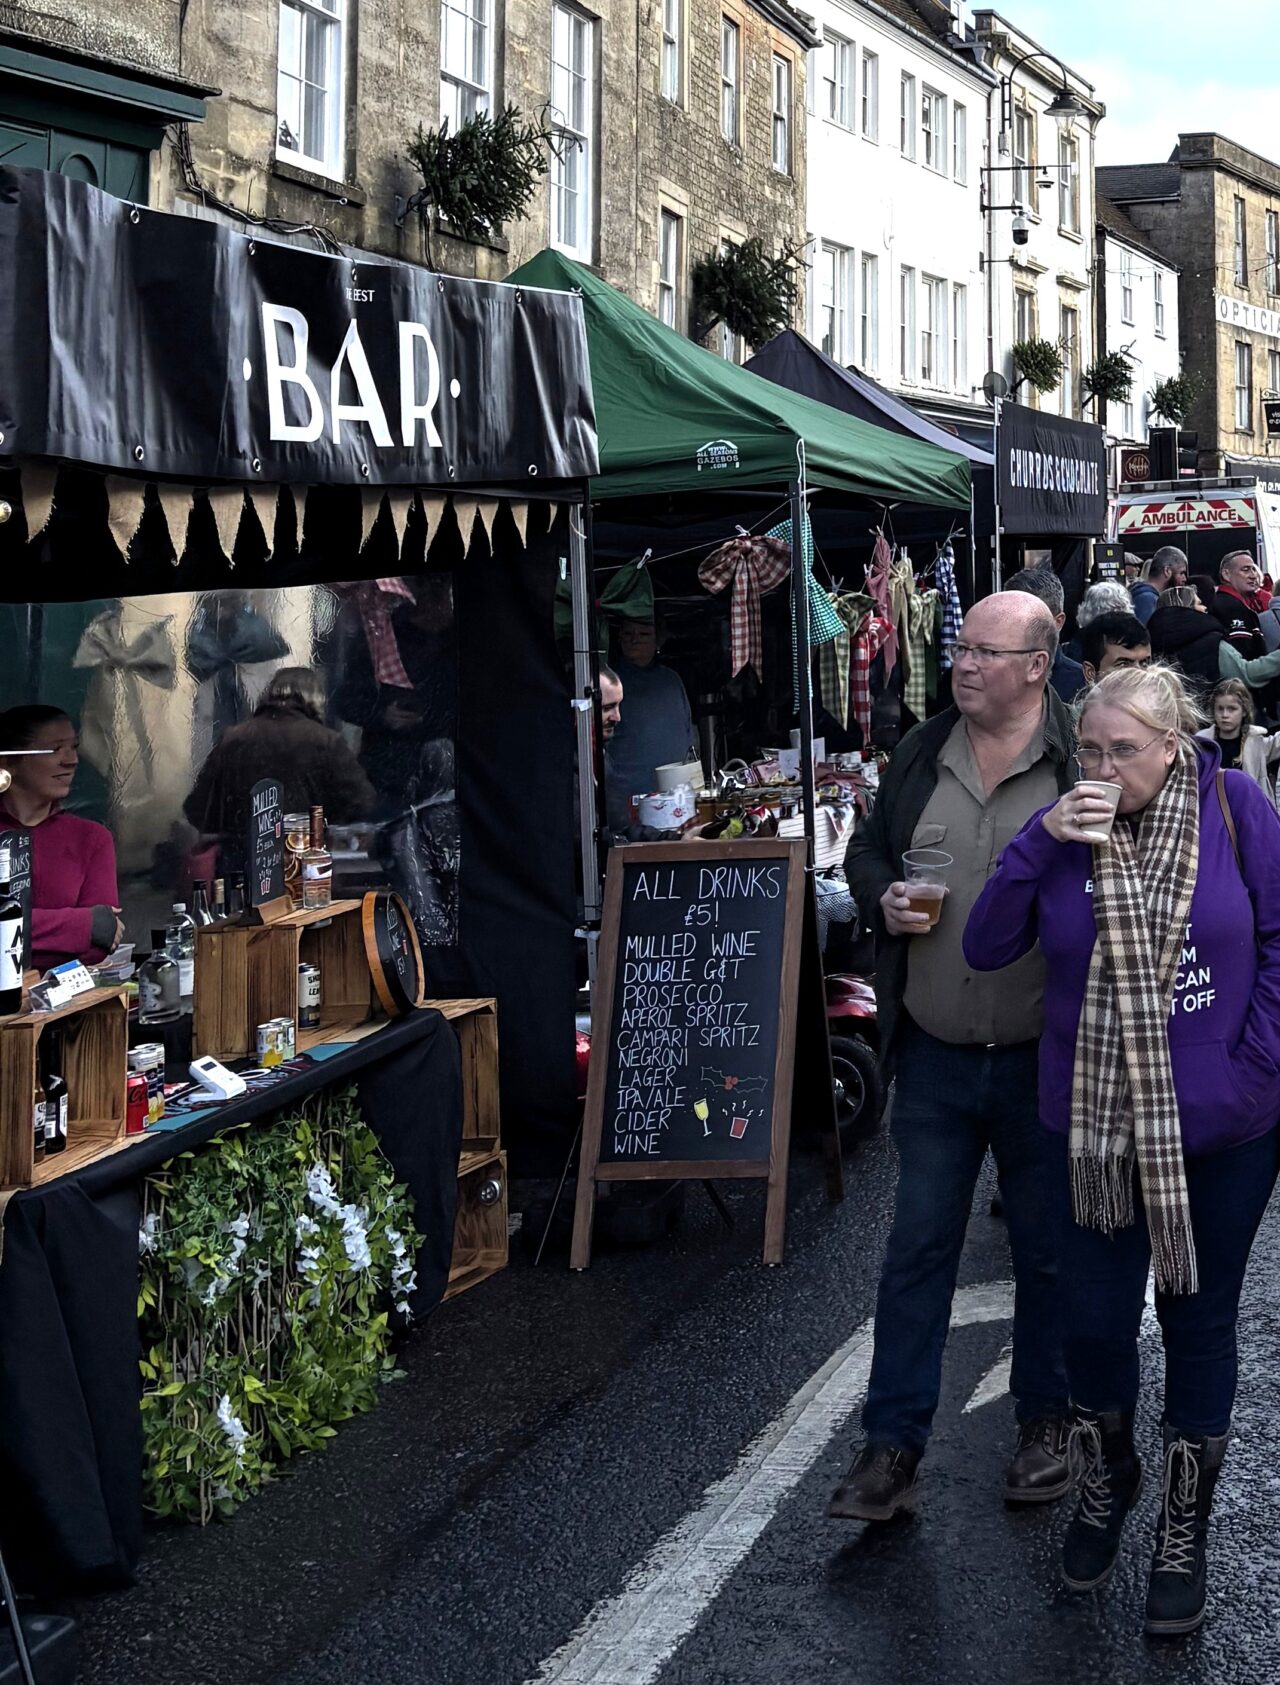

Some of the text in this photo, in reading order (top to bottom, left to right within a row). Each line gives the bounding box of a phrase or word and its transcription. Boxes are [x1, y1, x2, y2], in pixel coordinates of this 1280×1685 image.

[262, 301, 444, 448] BAR
[1010, 447, 1055, 491] CHURROS
[1141, 509, 1237, 526] AMBULANCE
[633, 866, 780, 901] ALL DRINKS
[684, 901, 720, 927] £5!
[625, 930, 761, 959] MULLED WINE
[624, 958, 745, 984] DOUBLE G&T
[1175, 967, 1211, 990] CAN
[623, 984, 723, 1008] PROSECCO
[1183, 989, 1216, 1013] OFF
[620, 1003, 748, 1029] APEROL SPRITZ
[617, 1025, 759, 1050] CAMPARI SPRITZ
[618, 1047, 688, 1069] NEGRONI
[618, 1065, 677, 1089] LAGER
[617, 1086, 687, 1110] IPA/ALE
[614, 1109, 672, 1134] CIDER
[614, 1133, 662, 1155] WINE
